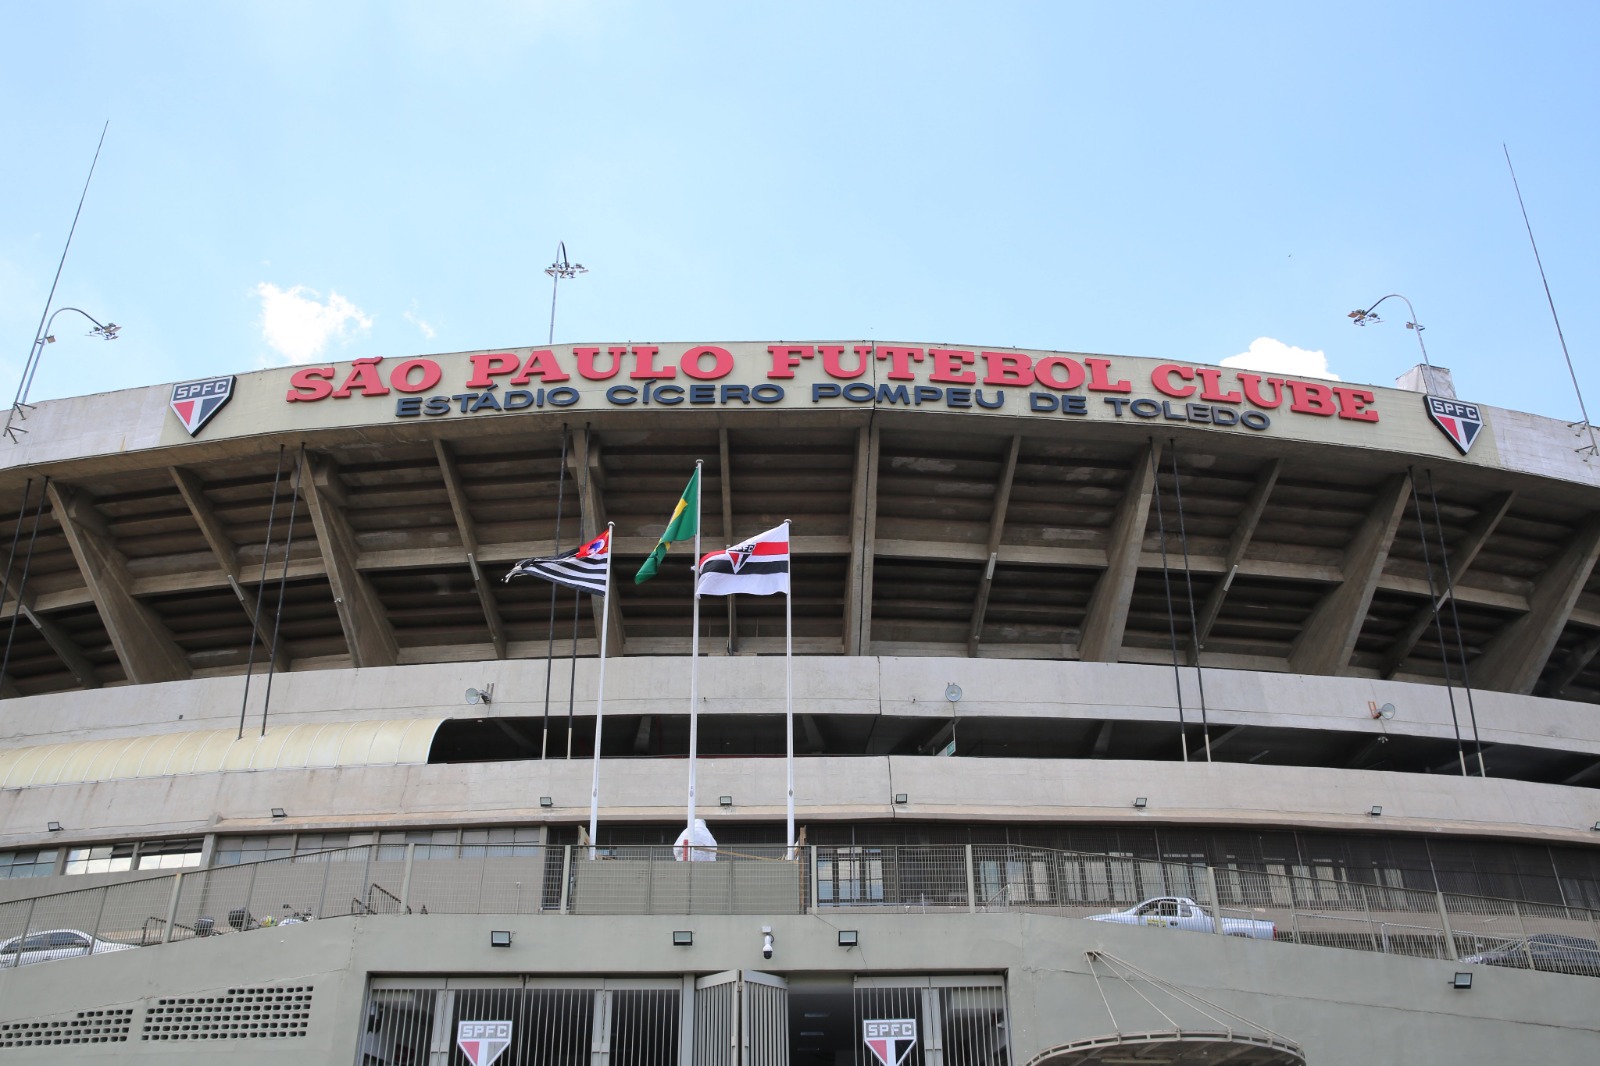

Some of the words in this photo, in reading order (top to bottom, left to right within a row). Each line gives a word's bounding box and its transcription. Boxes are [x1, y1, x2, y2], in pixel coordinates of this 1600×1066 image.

[176, 381, 227, 399] SPFC
[286, 356, 442, 402] SÃO
[466, 346, 734, 388] PAULO
[767, 345, 1131, 392] FUTEBOL
[1151, 364, 1379, 422] CLUBE
[395, 384, 580, 417] ESTÁDIO
[606, 378, 785, 405] CÍCERO
[812, 383, 1005, 409] POMPEU
[1030, 392, 1088, 415] DE
[1104, 397, 1270, 430] TOLEDO
[1433, 400, 1477, 419] SPFC
[462, 1025, 507, 1037] SPFC
[868, 1023, 912, 1036] SPFC
